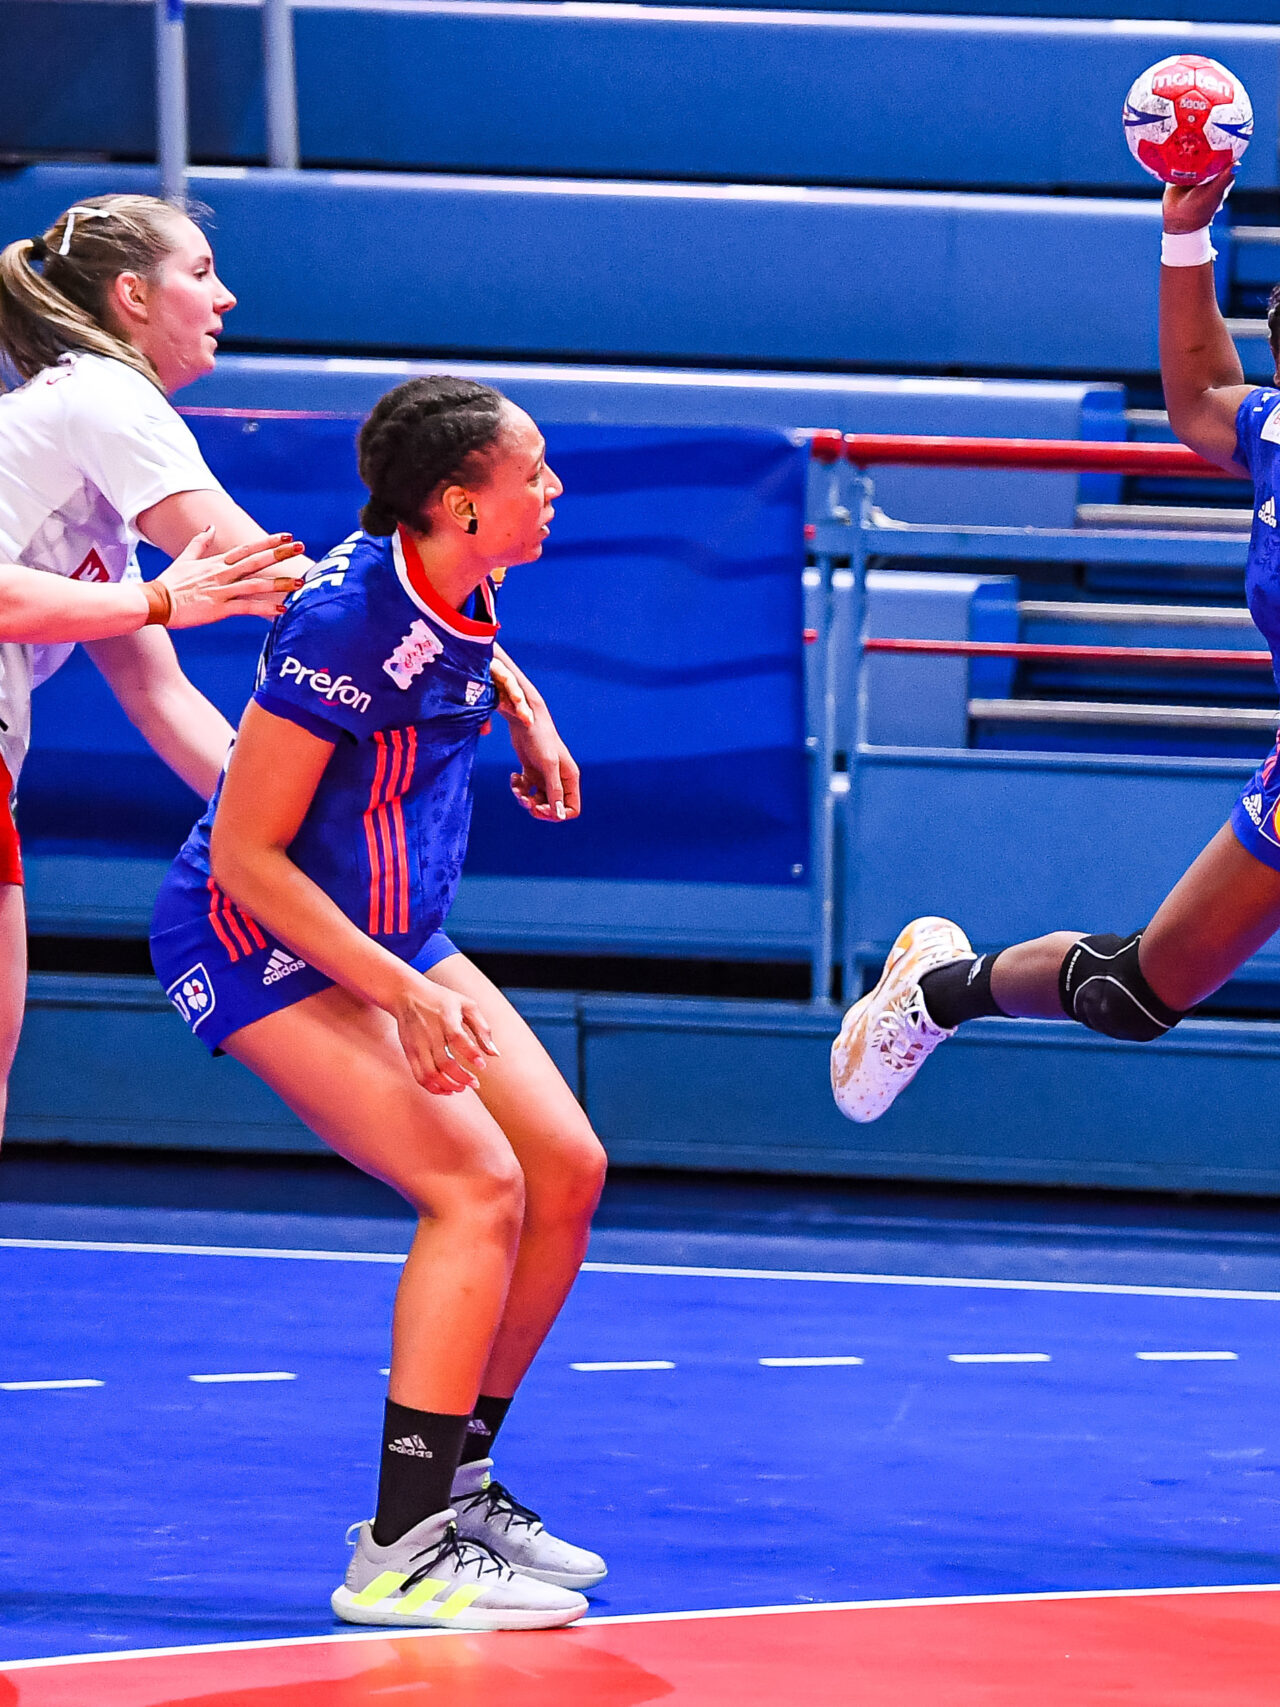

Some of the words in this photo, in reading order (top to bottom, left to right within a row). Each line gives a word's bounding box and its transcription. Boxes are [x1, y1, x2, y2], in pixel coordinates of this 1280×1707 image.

[1153, 70, 1231, 97] molten
[262, 959, 307, 986] adidas
[387, 1443, 433, 1459] adidas
